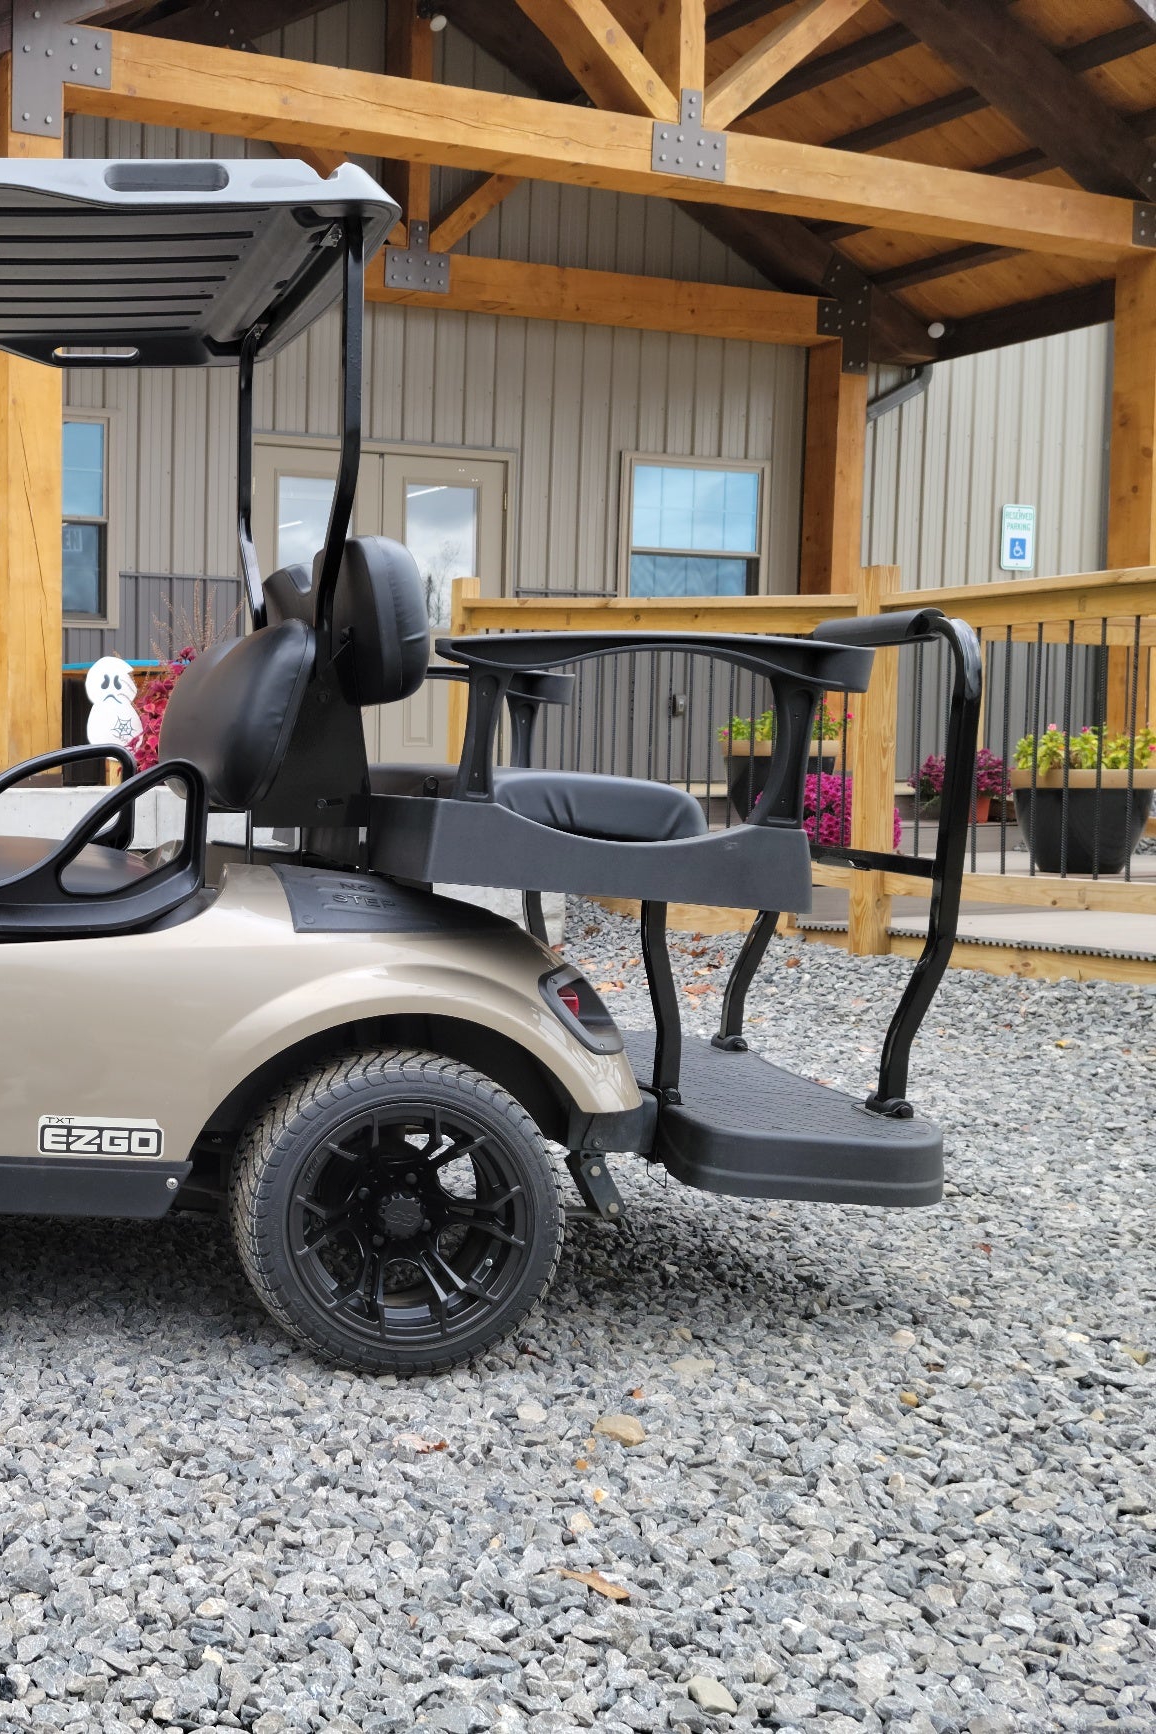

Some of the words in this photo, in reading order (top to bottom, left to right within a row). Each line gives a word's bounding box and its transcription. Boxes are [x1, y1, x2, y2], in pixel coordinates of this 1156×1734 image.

[1005, 511, 1033, 521] RESERVED
[1006, 522, 1031, 531] PARKING
[339, 882, 376, 893] NO
[332, 894, 396, 908] STEP
[45, 1116, 75, 1125] TXT
[43, 1127, 158, 1154] EZGO
